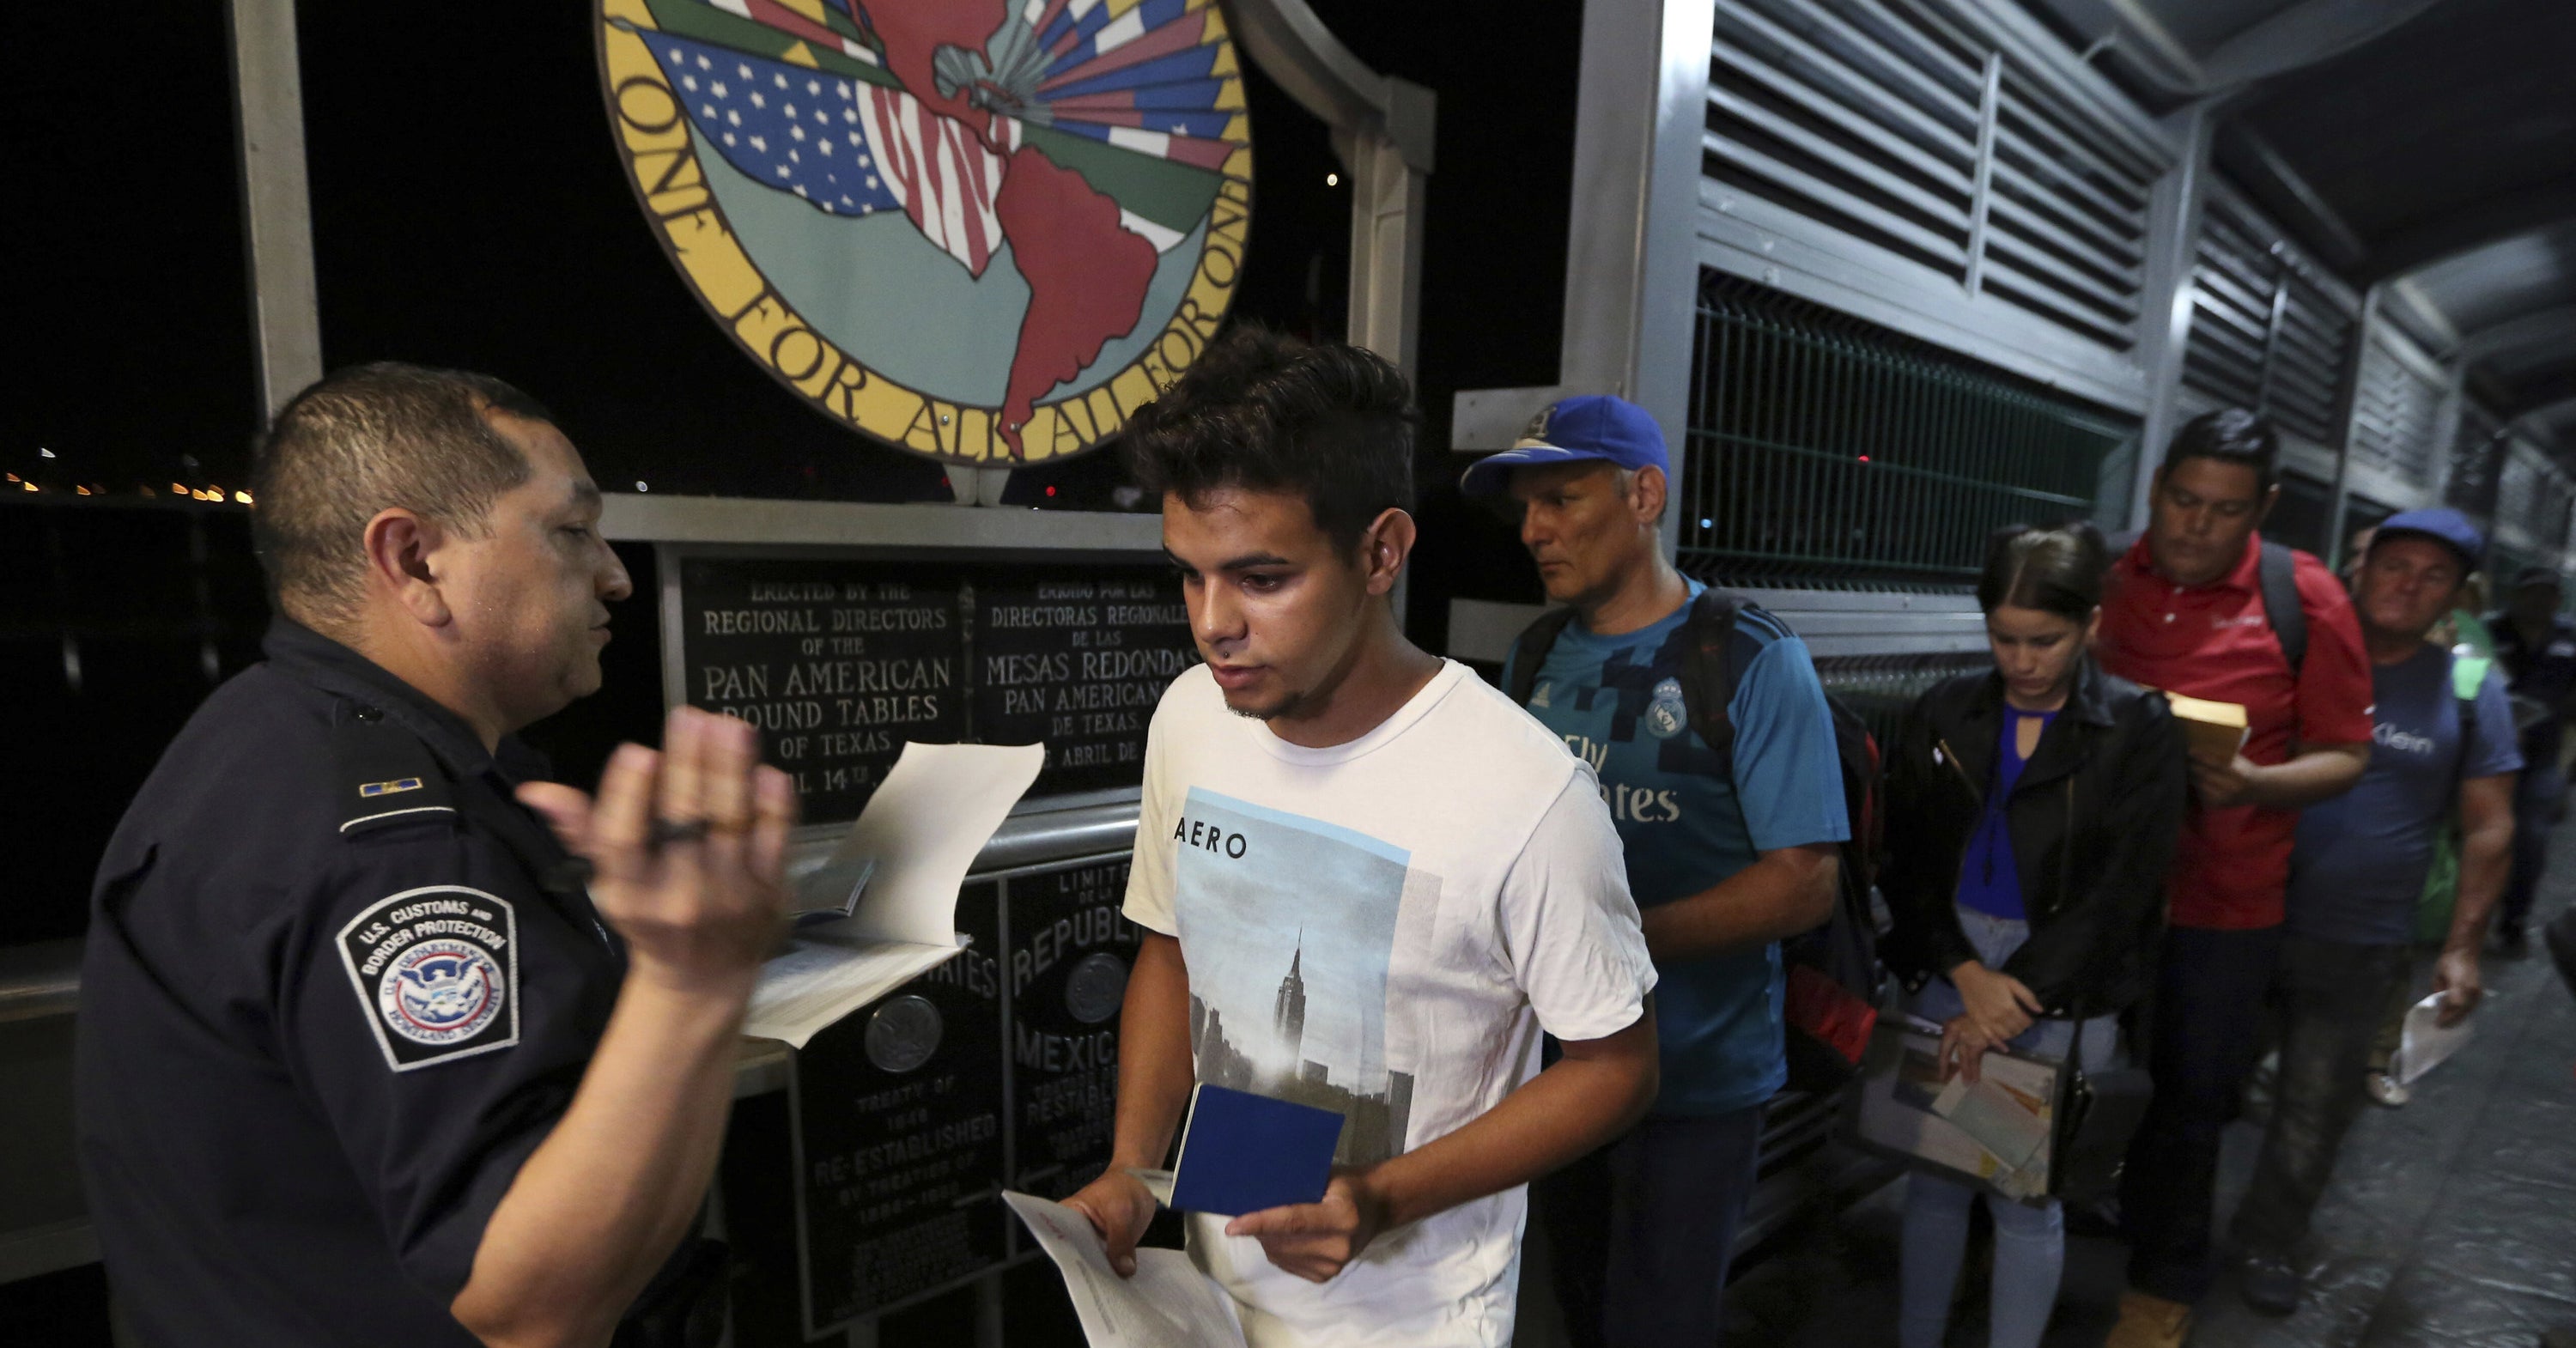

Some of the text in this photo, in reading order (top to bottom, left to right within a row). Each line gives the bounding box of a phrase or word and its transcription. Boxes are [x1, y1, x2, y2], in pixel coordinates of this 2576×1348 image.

[616, 76, 729, 254] ONE
[730, 288, 867, 422] FOR
[1140, 297, 1222, 394] FOR
[1203, 179, 1250, 288] ONE
[704, 608, 947, 635] REGIONAL DIRECTORS
[991, 604, 1188, 628] DIRECTORAS REGIONALE
[801, 637, 866, 657] OF THE
[1072, 630, 1122, 647] DE LAS
[703, 658, 951, 701] PAN AMERICAN
[987, 652, 1070, 686] MESAS
[836, 695, 939, 727] TABLES
[1005, 683, 1166, 715] PAN AMERICAN
[1052, 716, 1073, 737] DE
[780, 732, 891, 760] OF TEXAS
[1062, 744, 1112, 768] ABRIL
[1119, 741, 1139, 762] DE
[1174, 817, 1247, 859] AERO
[359, 921, 391, 944] U.S.
[390, 900, 470, 924] CUSTOMS
[361, 920, 507, 976] BORDER PROTECTION
[1013, 904, 1148, 999] REPUBLI
[1016, 1022, 1115, 1074] MEXIC
